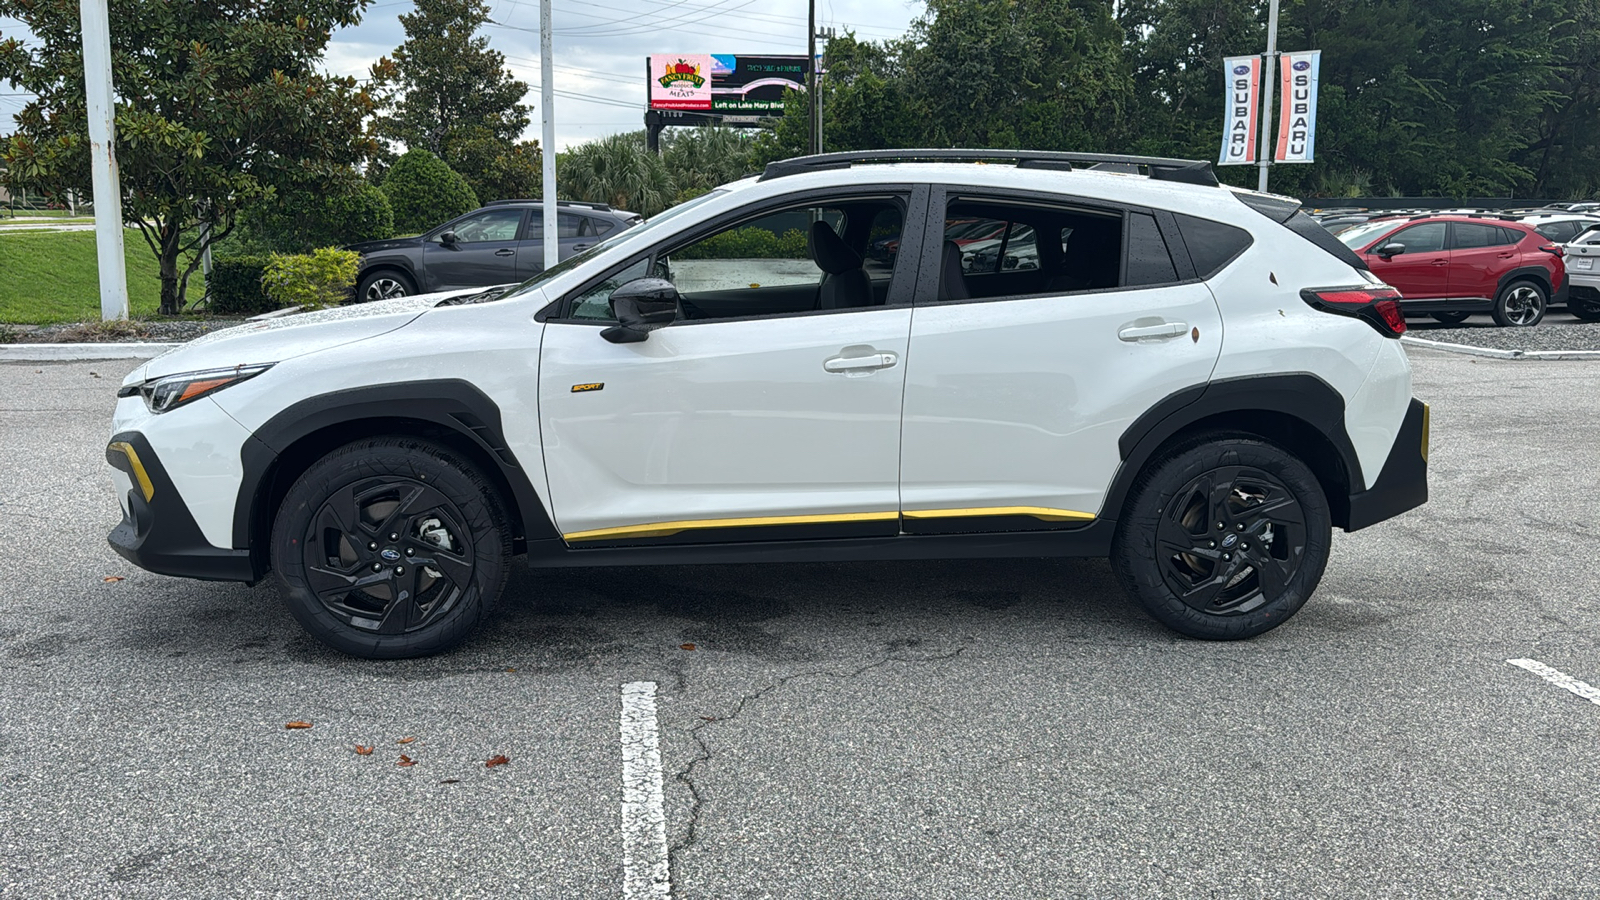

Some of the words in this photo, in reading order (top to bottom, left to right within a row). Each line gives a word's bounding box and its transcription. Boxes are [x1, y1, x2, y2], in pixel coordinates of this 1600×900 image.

[660, 73, 682, 84] FANCY
[669, 90, 695, 98] MEATS
[754, 102, 769, 110] Mary
[1230, 79, 1248, 157] SUBARU
[1291, 75, 1308, 155] SUBARU
[573, 383, 600, 391] SPORT
